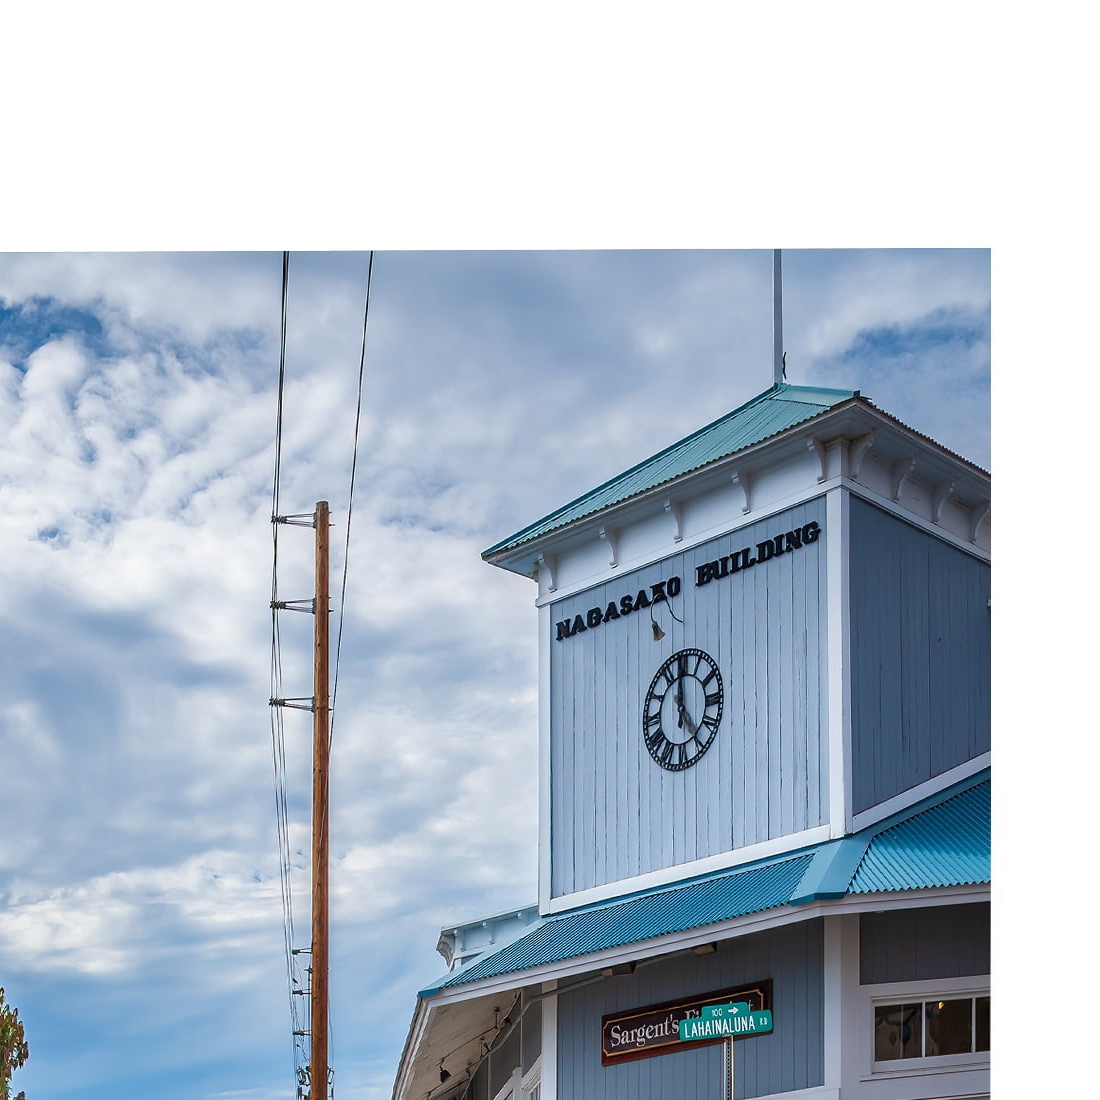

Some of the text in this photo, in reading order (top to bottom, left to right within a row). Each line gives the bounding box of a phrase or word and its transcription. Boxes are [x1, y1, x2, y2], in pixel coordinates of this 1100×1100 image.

[556, 521, 821, 641] NAGASAKO BUILDING
[684, 1015, 768, 1038] LAHAINALUNA RD
[711, 1008, 723, 1017] 100
[610, 1013, 679, 1047] Sargent's
